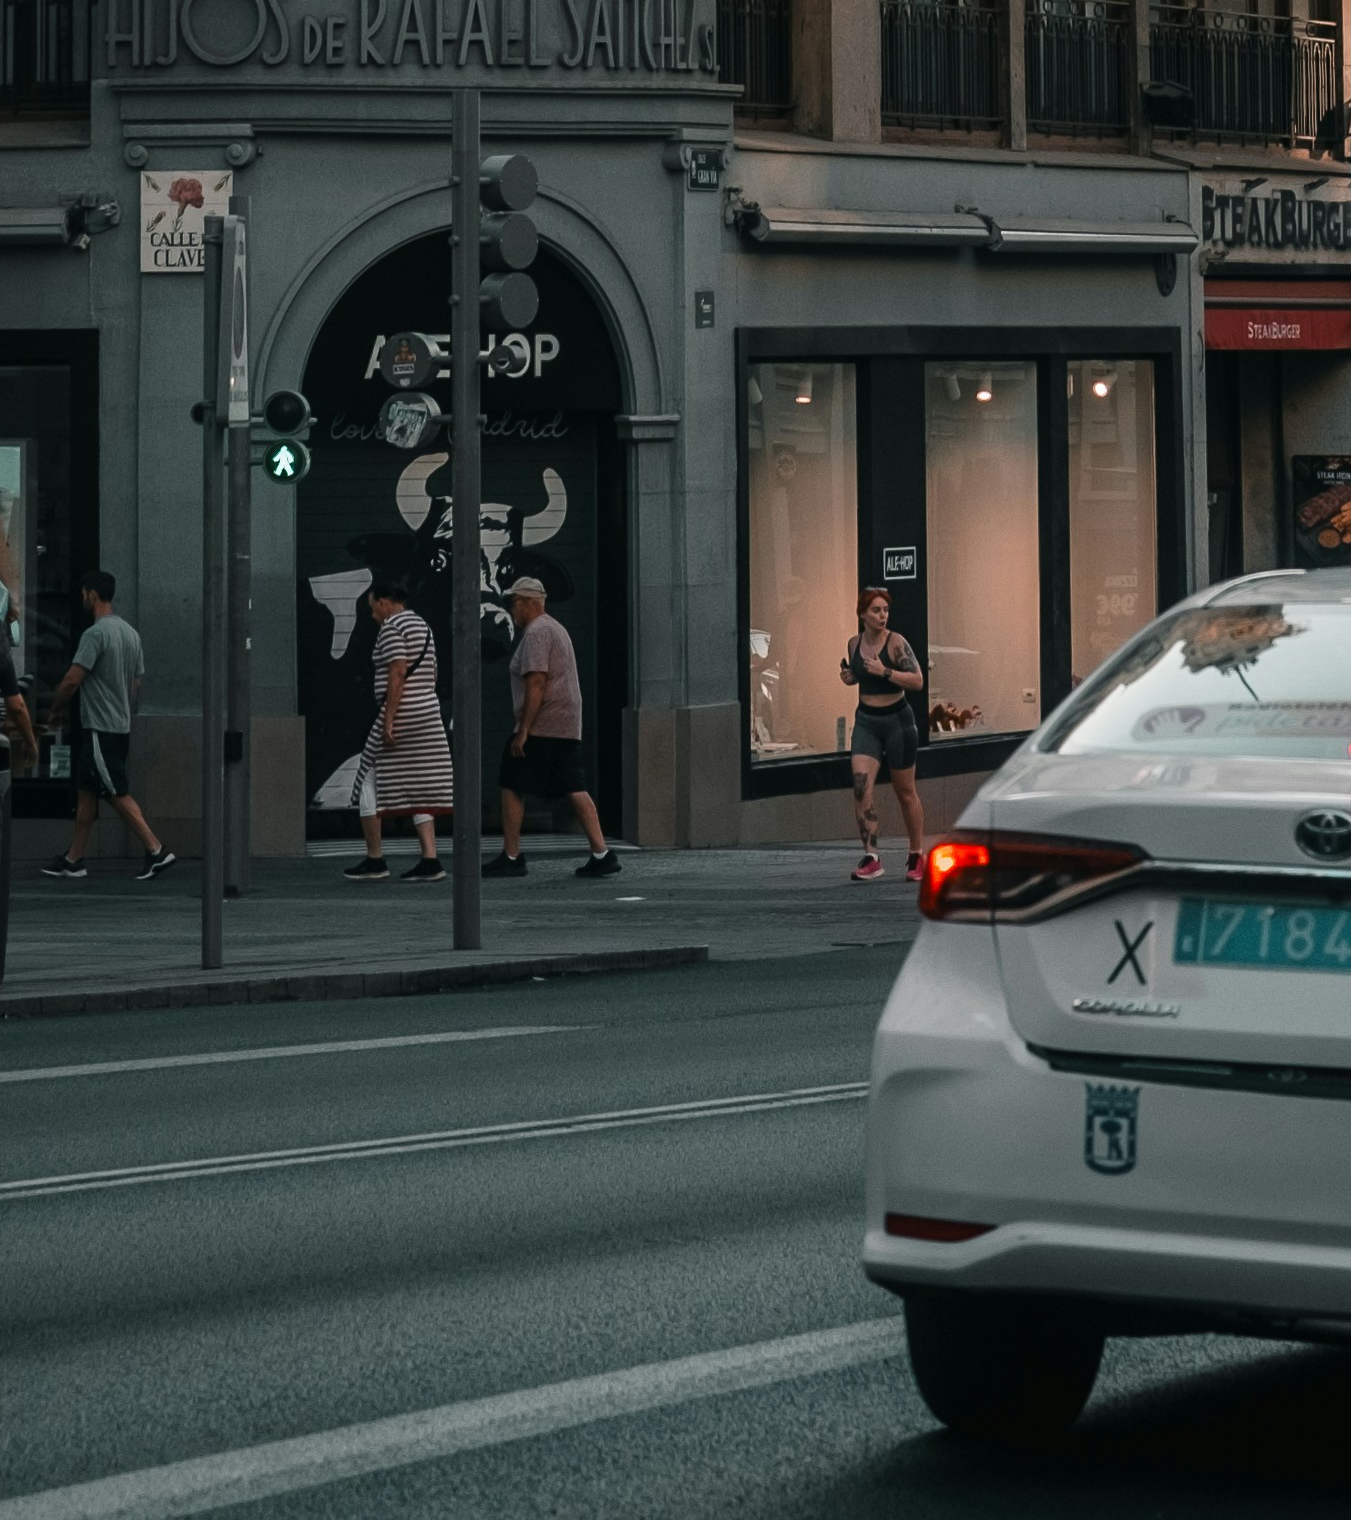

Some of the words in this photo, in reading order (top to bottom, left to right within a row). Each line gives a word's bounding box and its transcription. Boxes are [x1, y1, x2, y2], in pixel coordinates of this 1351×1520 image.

[303, 15, 346, 66] DE
[150, 232, 198, 247] CALLE
[154, 248, 205, 267] CLAVE
[1108, 919, 1154, 986] X
